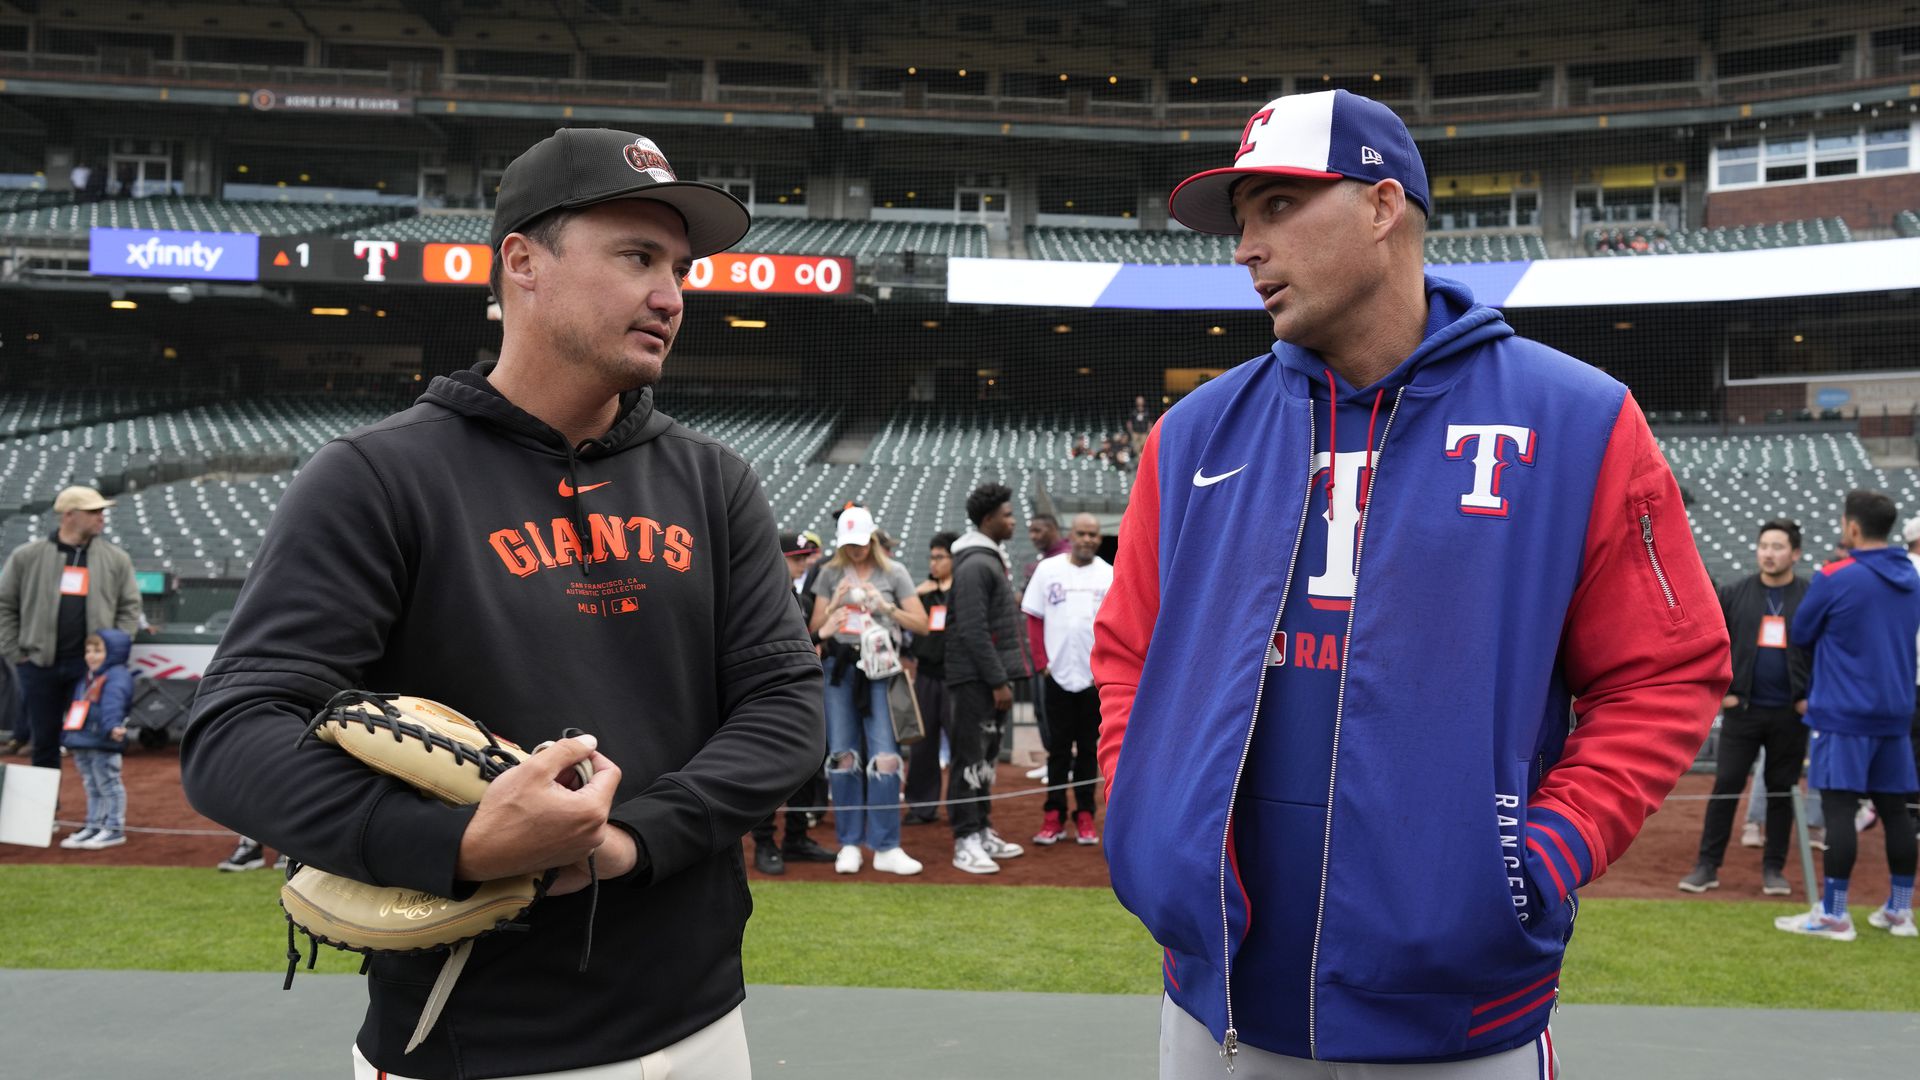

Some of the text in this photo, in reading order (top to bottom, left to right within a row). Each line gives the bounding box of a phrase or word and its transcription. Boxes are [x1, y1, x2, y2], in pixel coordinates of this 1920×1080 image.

[126, 237, 224, 271] xfinity
[296, 240, 472, 282] 1 T 0
[1445, 424, 1537, 518] T
[488, 513, 694, 577] GIANTS
[1307, 450, 1380, 611] T
[566, 583, 647, 597] AUTHENTIC COLLECTION
[627, 577, 638, 585] CA
[578, 602, 598, 614] MLB
[1294, 632, 1348, 670] RA
